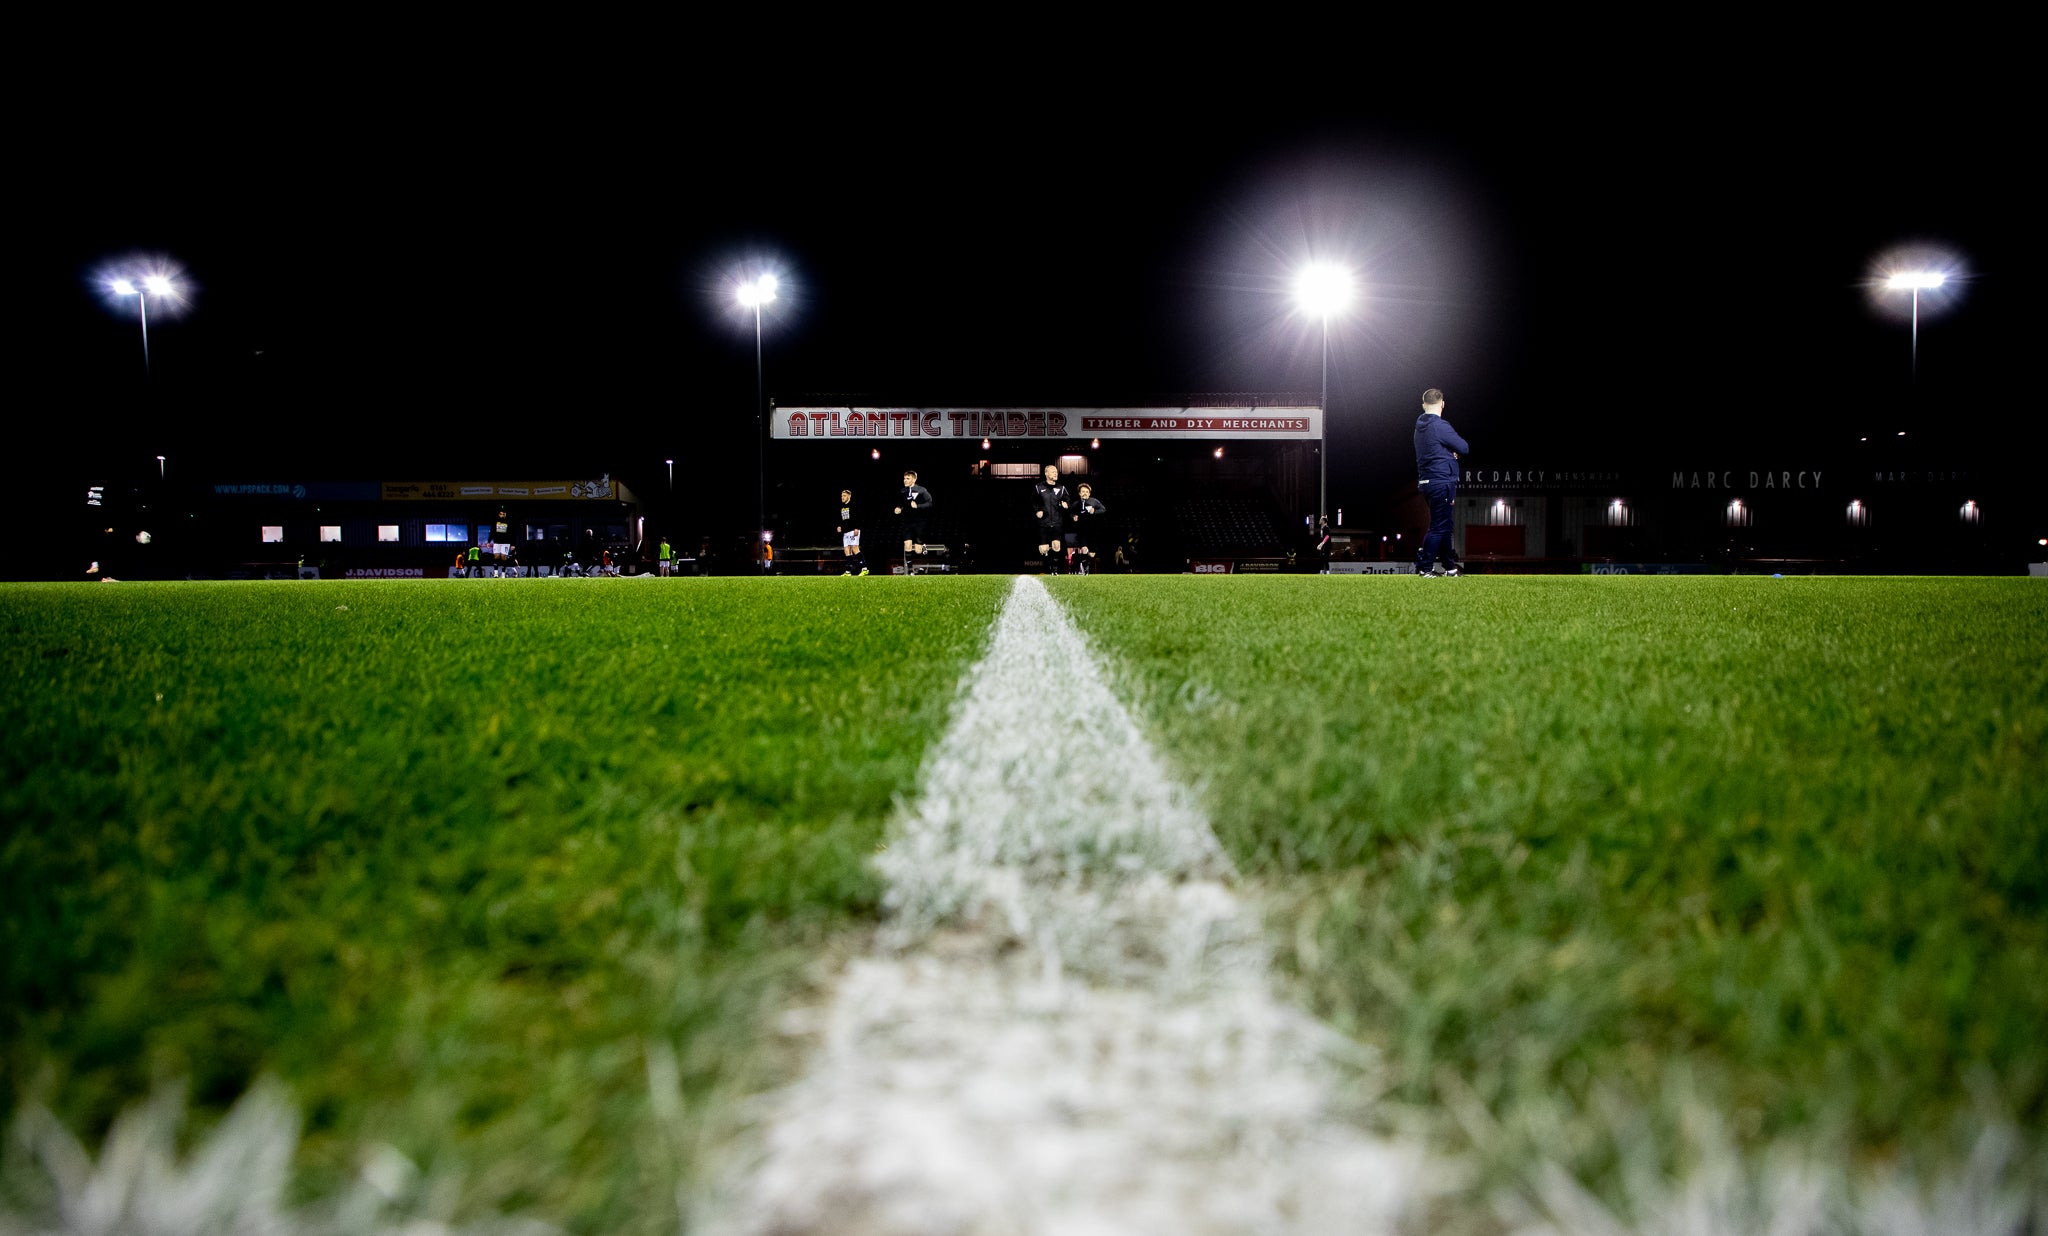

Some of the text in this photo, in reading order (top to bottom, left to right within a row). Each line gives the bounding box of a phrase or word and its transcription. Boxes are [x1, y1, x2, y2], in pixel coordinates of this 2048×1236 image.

[788, 411, 1068, 437] ATLANTIC TIMBER
[1088, 419, 1304, 429] TIMBER AND DIY MERCHANTS
[1493, 470, 1545, 482] DARCY
[1555, 472, 1621, 481] MENSWEAR
[1672, 471, 1822, 488] MARC DARCY
[345, 568, 424, 576] J.DAVIDSON
[1195, 563, 1226, 573] BIG
[1591, 563, 1639, 575] koko
